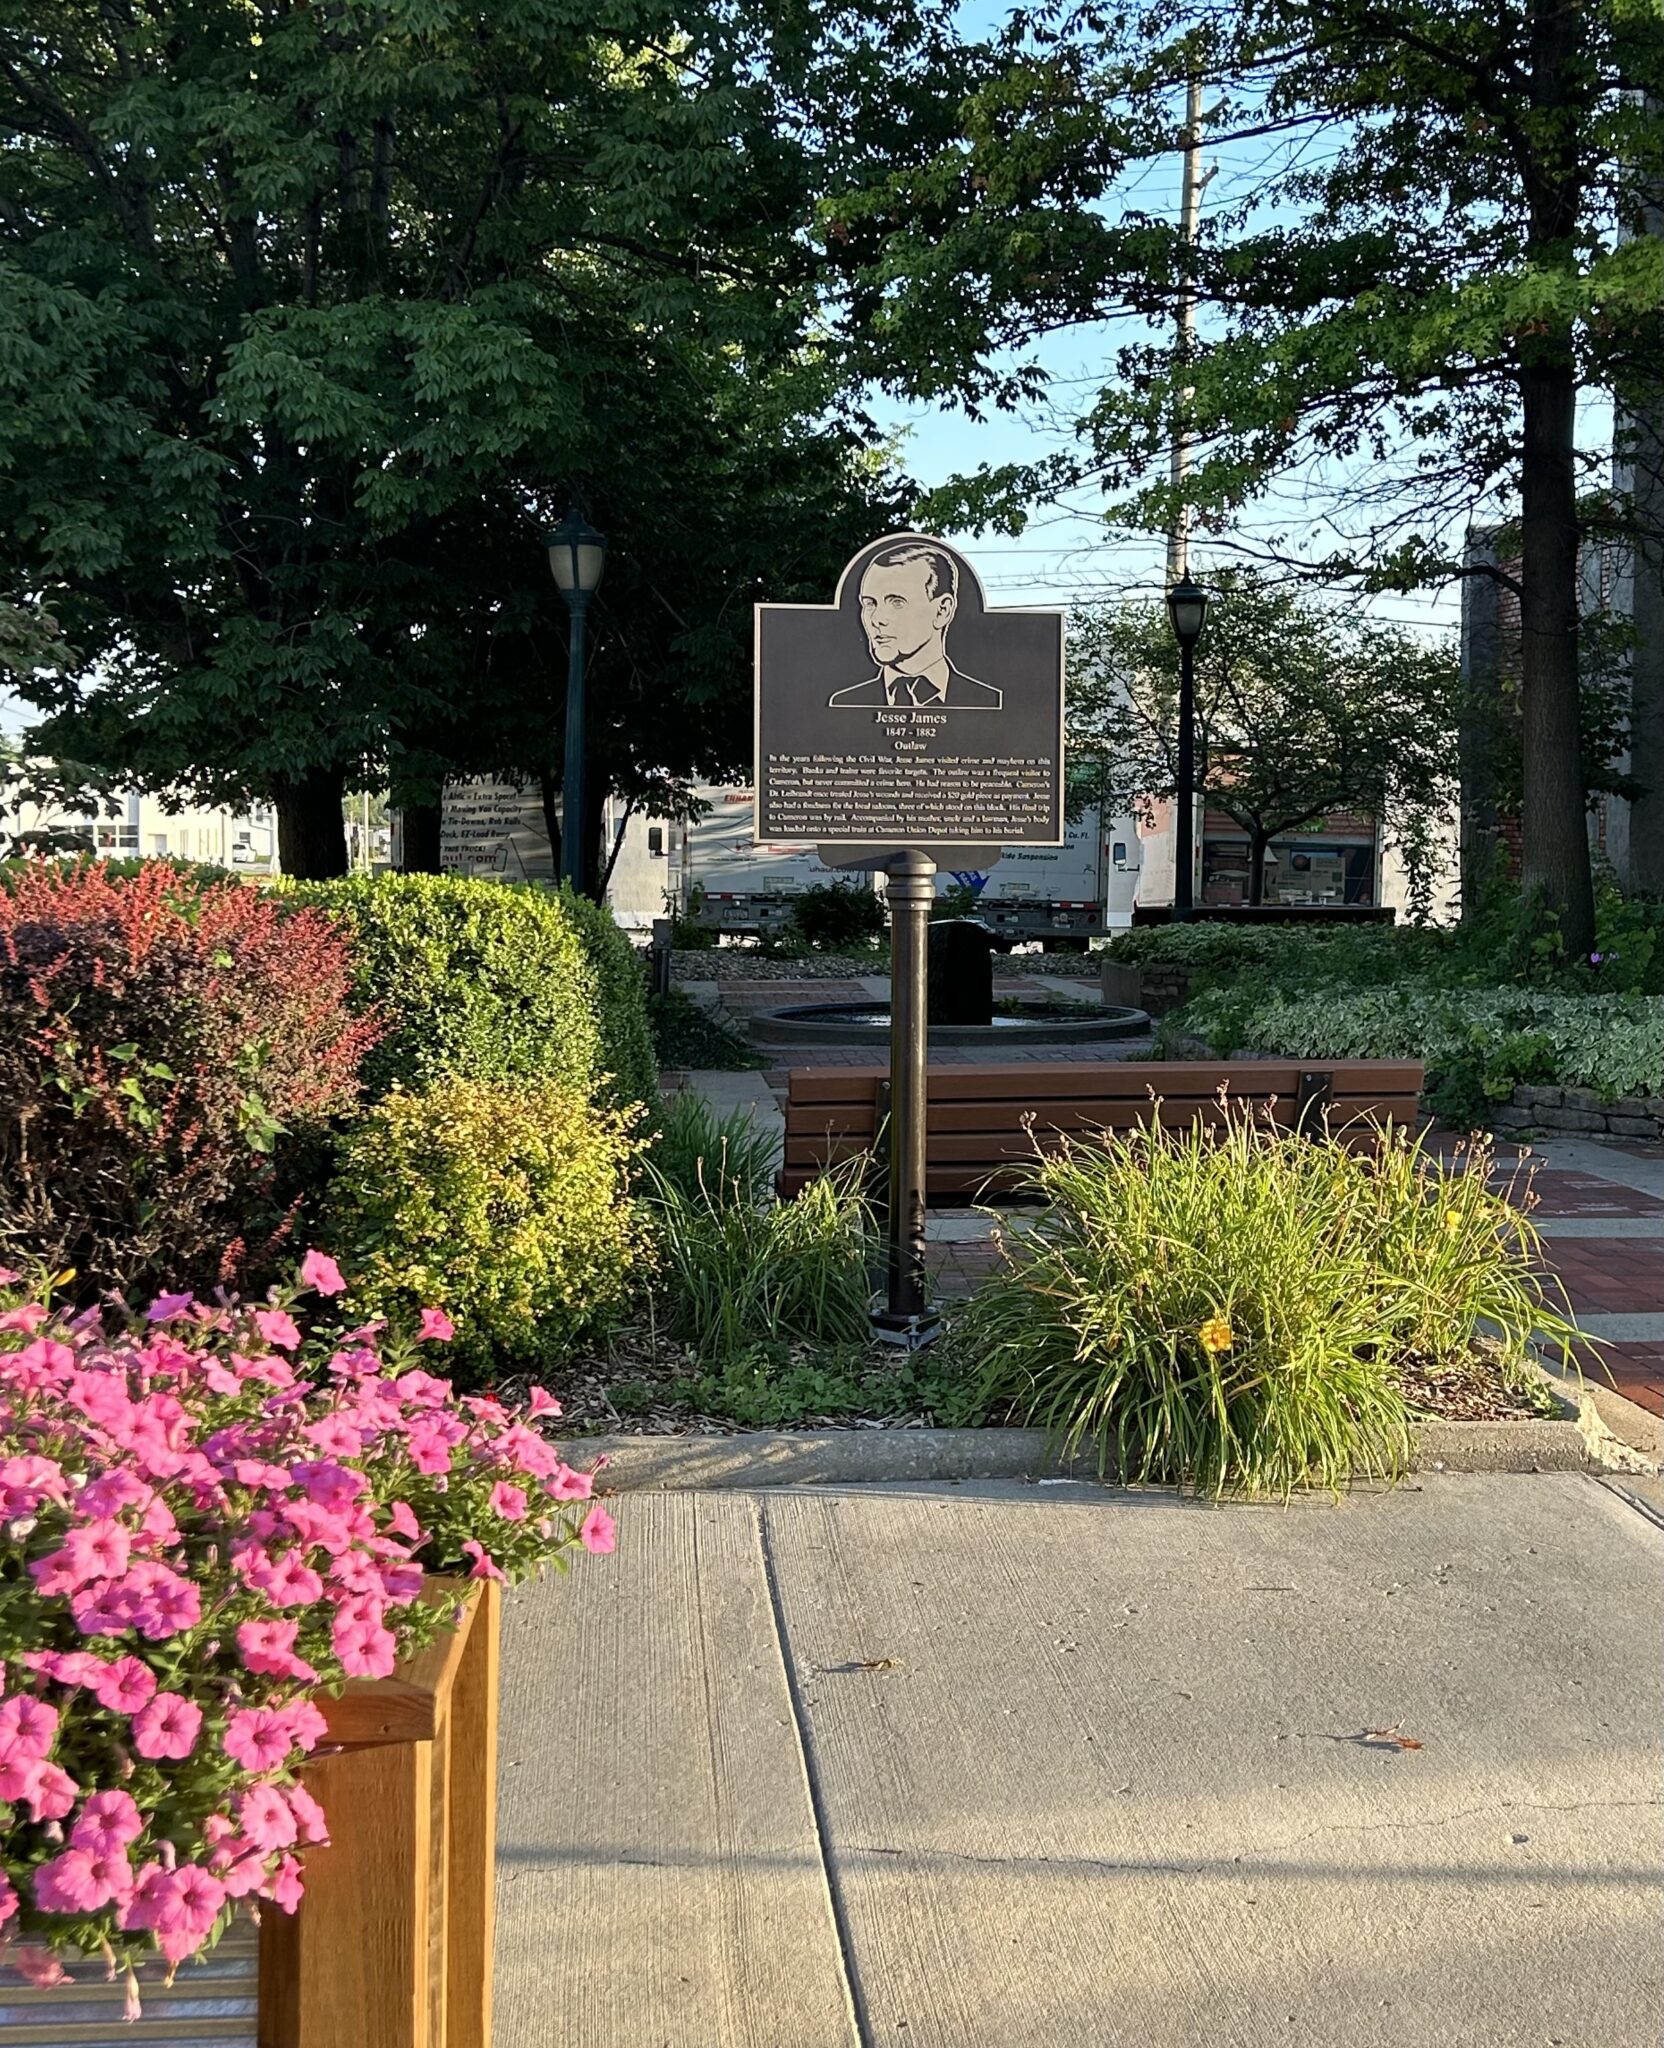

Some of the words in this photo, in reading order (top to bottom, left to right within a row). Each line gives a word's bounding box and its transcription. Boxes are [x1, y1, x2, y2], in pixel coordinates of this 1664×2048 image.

[875, 711, 907, 723] Jesse
[910, 712, 947, 723] James
[886, 727, 906, 737] 1847
[916, 727, 936, 737] 1882
[894, 741, 927, 750] Outlaw
[769, 754, 777, 762] In
[779, 754, 790, 762] the
[792, 756, 811, 764] years
[812, 754, 844, 764] following
[845, 754, 857, 763] the
[858, 755, 876, 763] Civil
[895, 755, 913, 764] Jesse
[914, 756, 935, 764] James
[936, 756, 959, 764] visited
[960, 756, 980, 764] crime
[981, 756, 995, 764] and
[996, 756, 1025, 766] mayhem
[1037, 757, 1051, 765] this
[768, 766, 798, 775] territory.
[802, 766, 824, 774] Banks
[825, 766, 839, 774] and
[878, 767, 903, 775] favorite
[932, 767, 946, 776] The
[947, 767, 970, 776] outlaw
[992, 768, 1020, 778] frequent
[1021, 768, 1041, 777] visitor
[1042, 769, 1051, 777] to
[833, 778, 870, 787] committed
[875, 778, 895, 787] crime
[915, 779, 926, 787] He
[926, 779, 940, 787] had
[962, 780, 970, 788] to
[1015, 780, 1050, 788] Cameron's
[829, 790, 853, 798] treated
[852, 790, 875, 798] Jesse's
[875, 790, 901, 798] wounds
[901, 790, 914, 798] and
[914, 790, 942, 799] received
[947, 791, 960, 799] $20
[960, 791, 976, 801] gold
[975, 791, 993, 801] piece
[1032, 792, 1051, 800] Jesse
[450, 805, 476, 814] Moving
[768, 800, 783, 809] also
[783, 801, 797, 809] had
[802, 801, 831, 809] fondness
[832, 801, 842, 809] for
[842, 801, 854, 810] the
[854, 801, 871, 810] local
[898, 802, 916, 810] three
[915, 802, 924, 810] of
[924, 802, 945, 810] which
[945, 802, 964, 811] stood
[973, 803, 986, 811] this
[986, 803, 1007, 811] block.
[1008, 803, 1021, 811] His
[1021, 803, 1037, 811] final
[1037, 803, 1051, 813] trip
[777, 813, 808, 821] Cameron
[823, 813, 833, 823] by
[850, 813, 895, 823] Accompanied
[895, 813, 904, 824] by
[906, 813, 917, 822] his
[943, 814, 961, 822] uncle
[962, 814, 976, 822] and
[1010, 815, 1032, 823] Jesse's
[1033, 815, 1050, 825] body
[783, 824, 806, 832] loaded
[827, 824, 851, 835] special
[851, 825, 867, 833] train
[875, 825, 906, 833] Cameron
[906, 825, 927, 834] Union
[927, 825, 948, 836] Depot
[948, 825, 970, 836] taking
[970, 826, 984, 834] him
[992, 826, 1003, 834] his
[1003, 826, 1025, 835] burial.
[1016, 852, 1059, 861] Suspension
